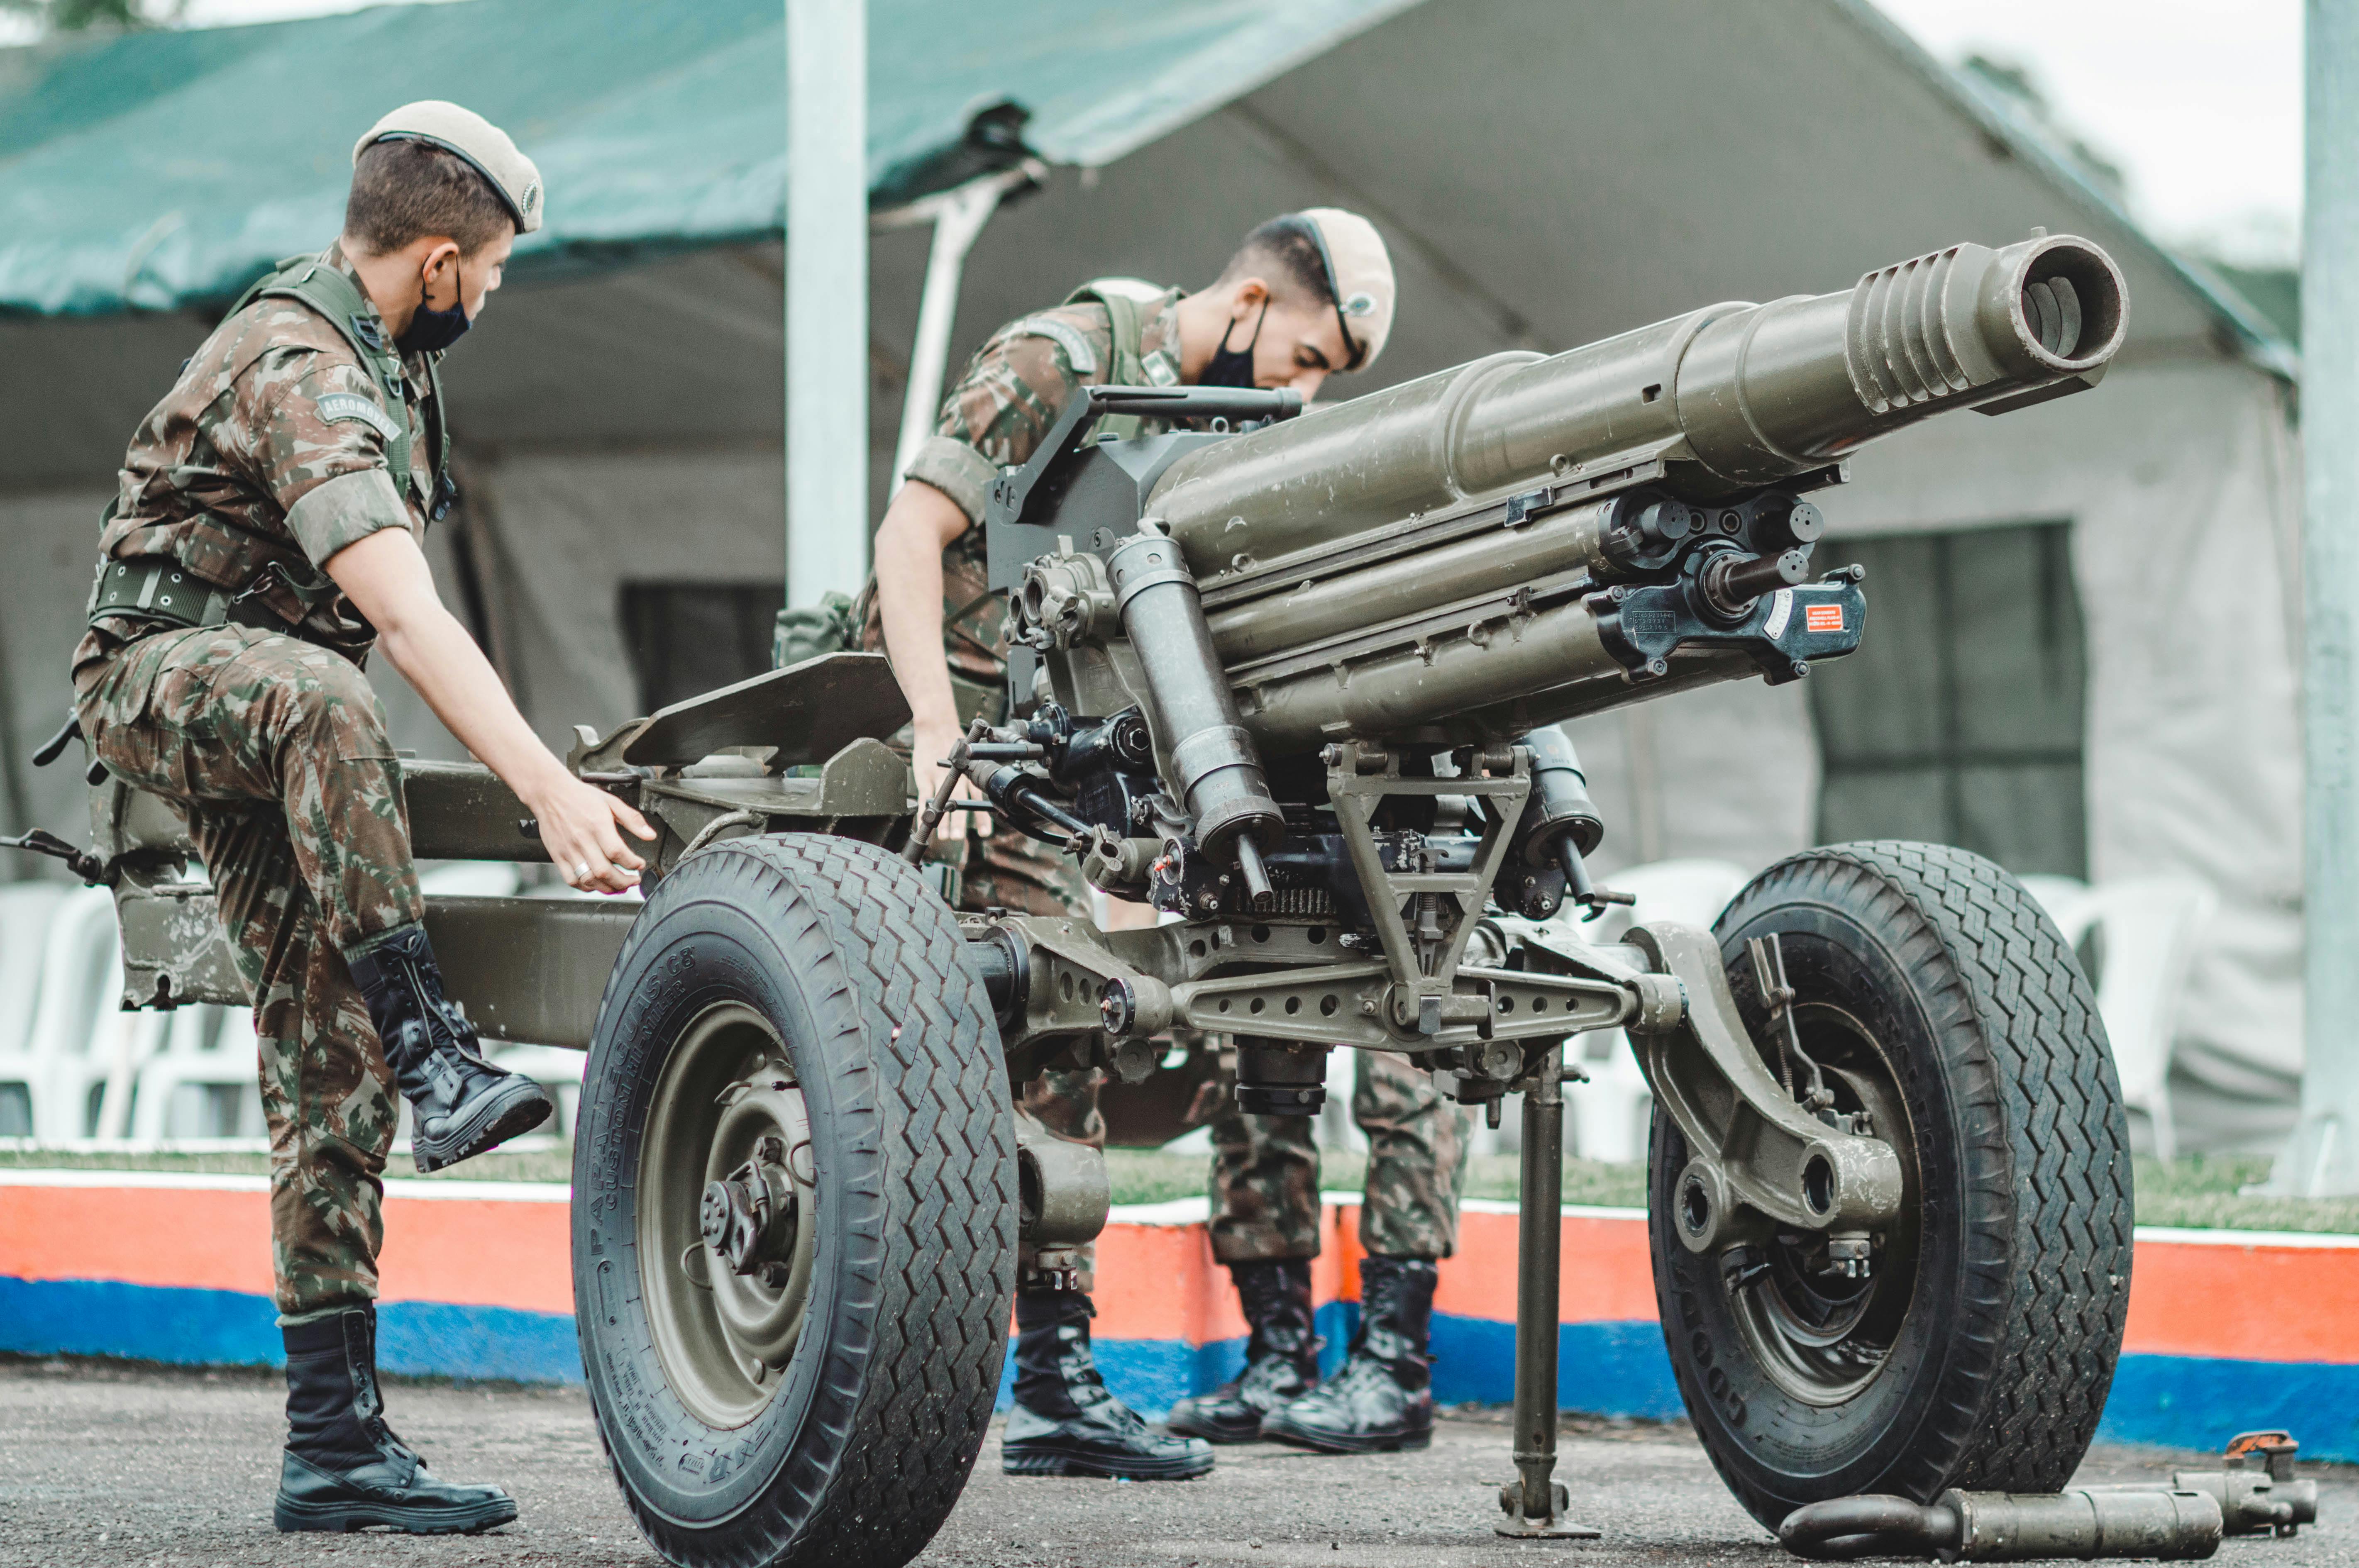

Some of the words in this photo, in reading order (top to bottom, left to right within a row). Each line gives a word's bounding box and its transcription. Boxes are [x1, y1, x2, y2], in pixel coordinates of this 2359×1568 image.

[324, 398, 391, 433] AEROMOVEL
[605, 1082, 634, 1211] CUSTOM
[627, 979, 686, 1079] HI-MILER
